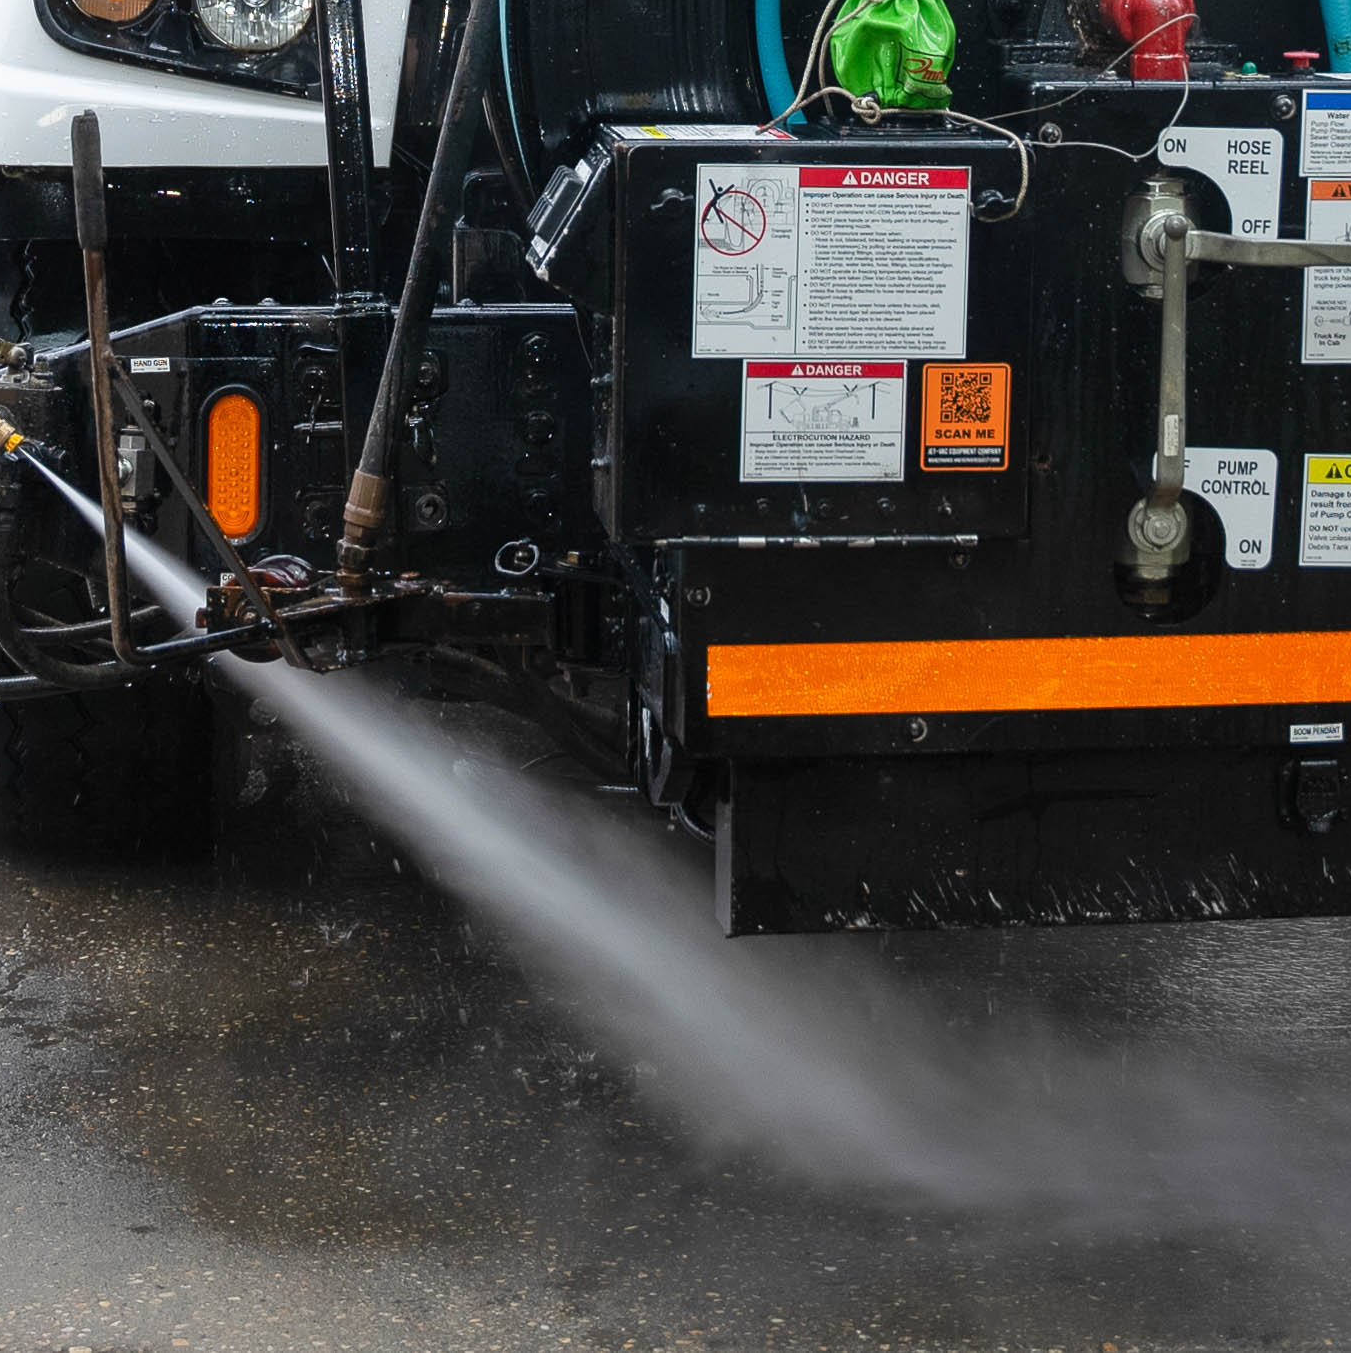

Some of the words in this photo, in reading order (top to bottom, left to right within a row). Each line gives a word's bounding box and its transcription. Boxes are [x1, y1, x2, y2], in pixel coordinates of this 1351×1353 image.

[1164, 138, 1186, 153] ON
[1227, 140, 1271, 155] HOSE
[1227, 160, 1269, 175] REEL
[860, 171, 930, 185] DANGER
[1241, 219, 1272, 234] OFF
[806, 365, 863, 376] DANGER
[934, 429, 971, 439] SCAN
[975, 429, 995, 439] ME
[1218, 460, 1258, 475] PUMP
[1201, 480, 1270, 496] CONTROL
[1310, 490, 1345, 499] Damage
[1309, 510, 1319, 518] of
[1320, 510, 1345, 519] Pump
[1238, 539, 1262, 554] ON
